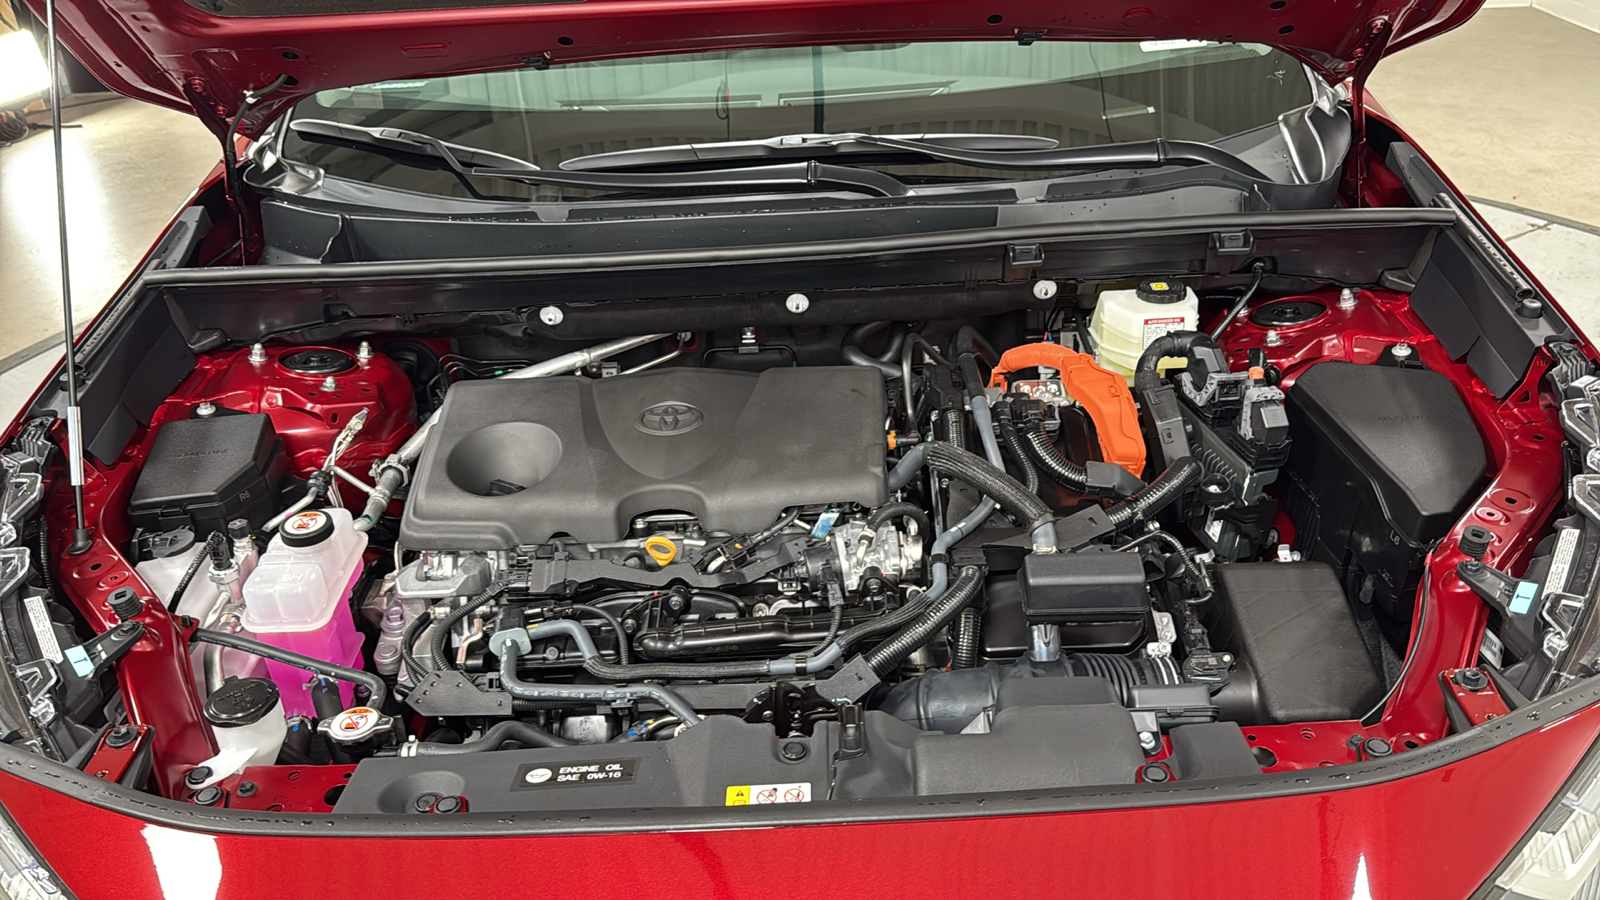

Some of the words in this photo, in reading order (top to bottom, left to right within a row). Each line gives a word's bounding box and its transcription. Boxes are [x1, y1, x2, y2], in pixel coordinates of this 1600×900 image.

[239, 490, 251, 502] R6
[559, 765, 600, 773] ENGINE
[604, 763, 623, 771] OIL
[557, 773, 580, 782] SAE
[586, 771, 622, 780] 0W-16
